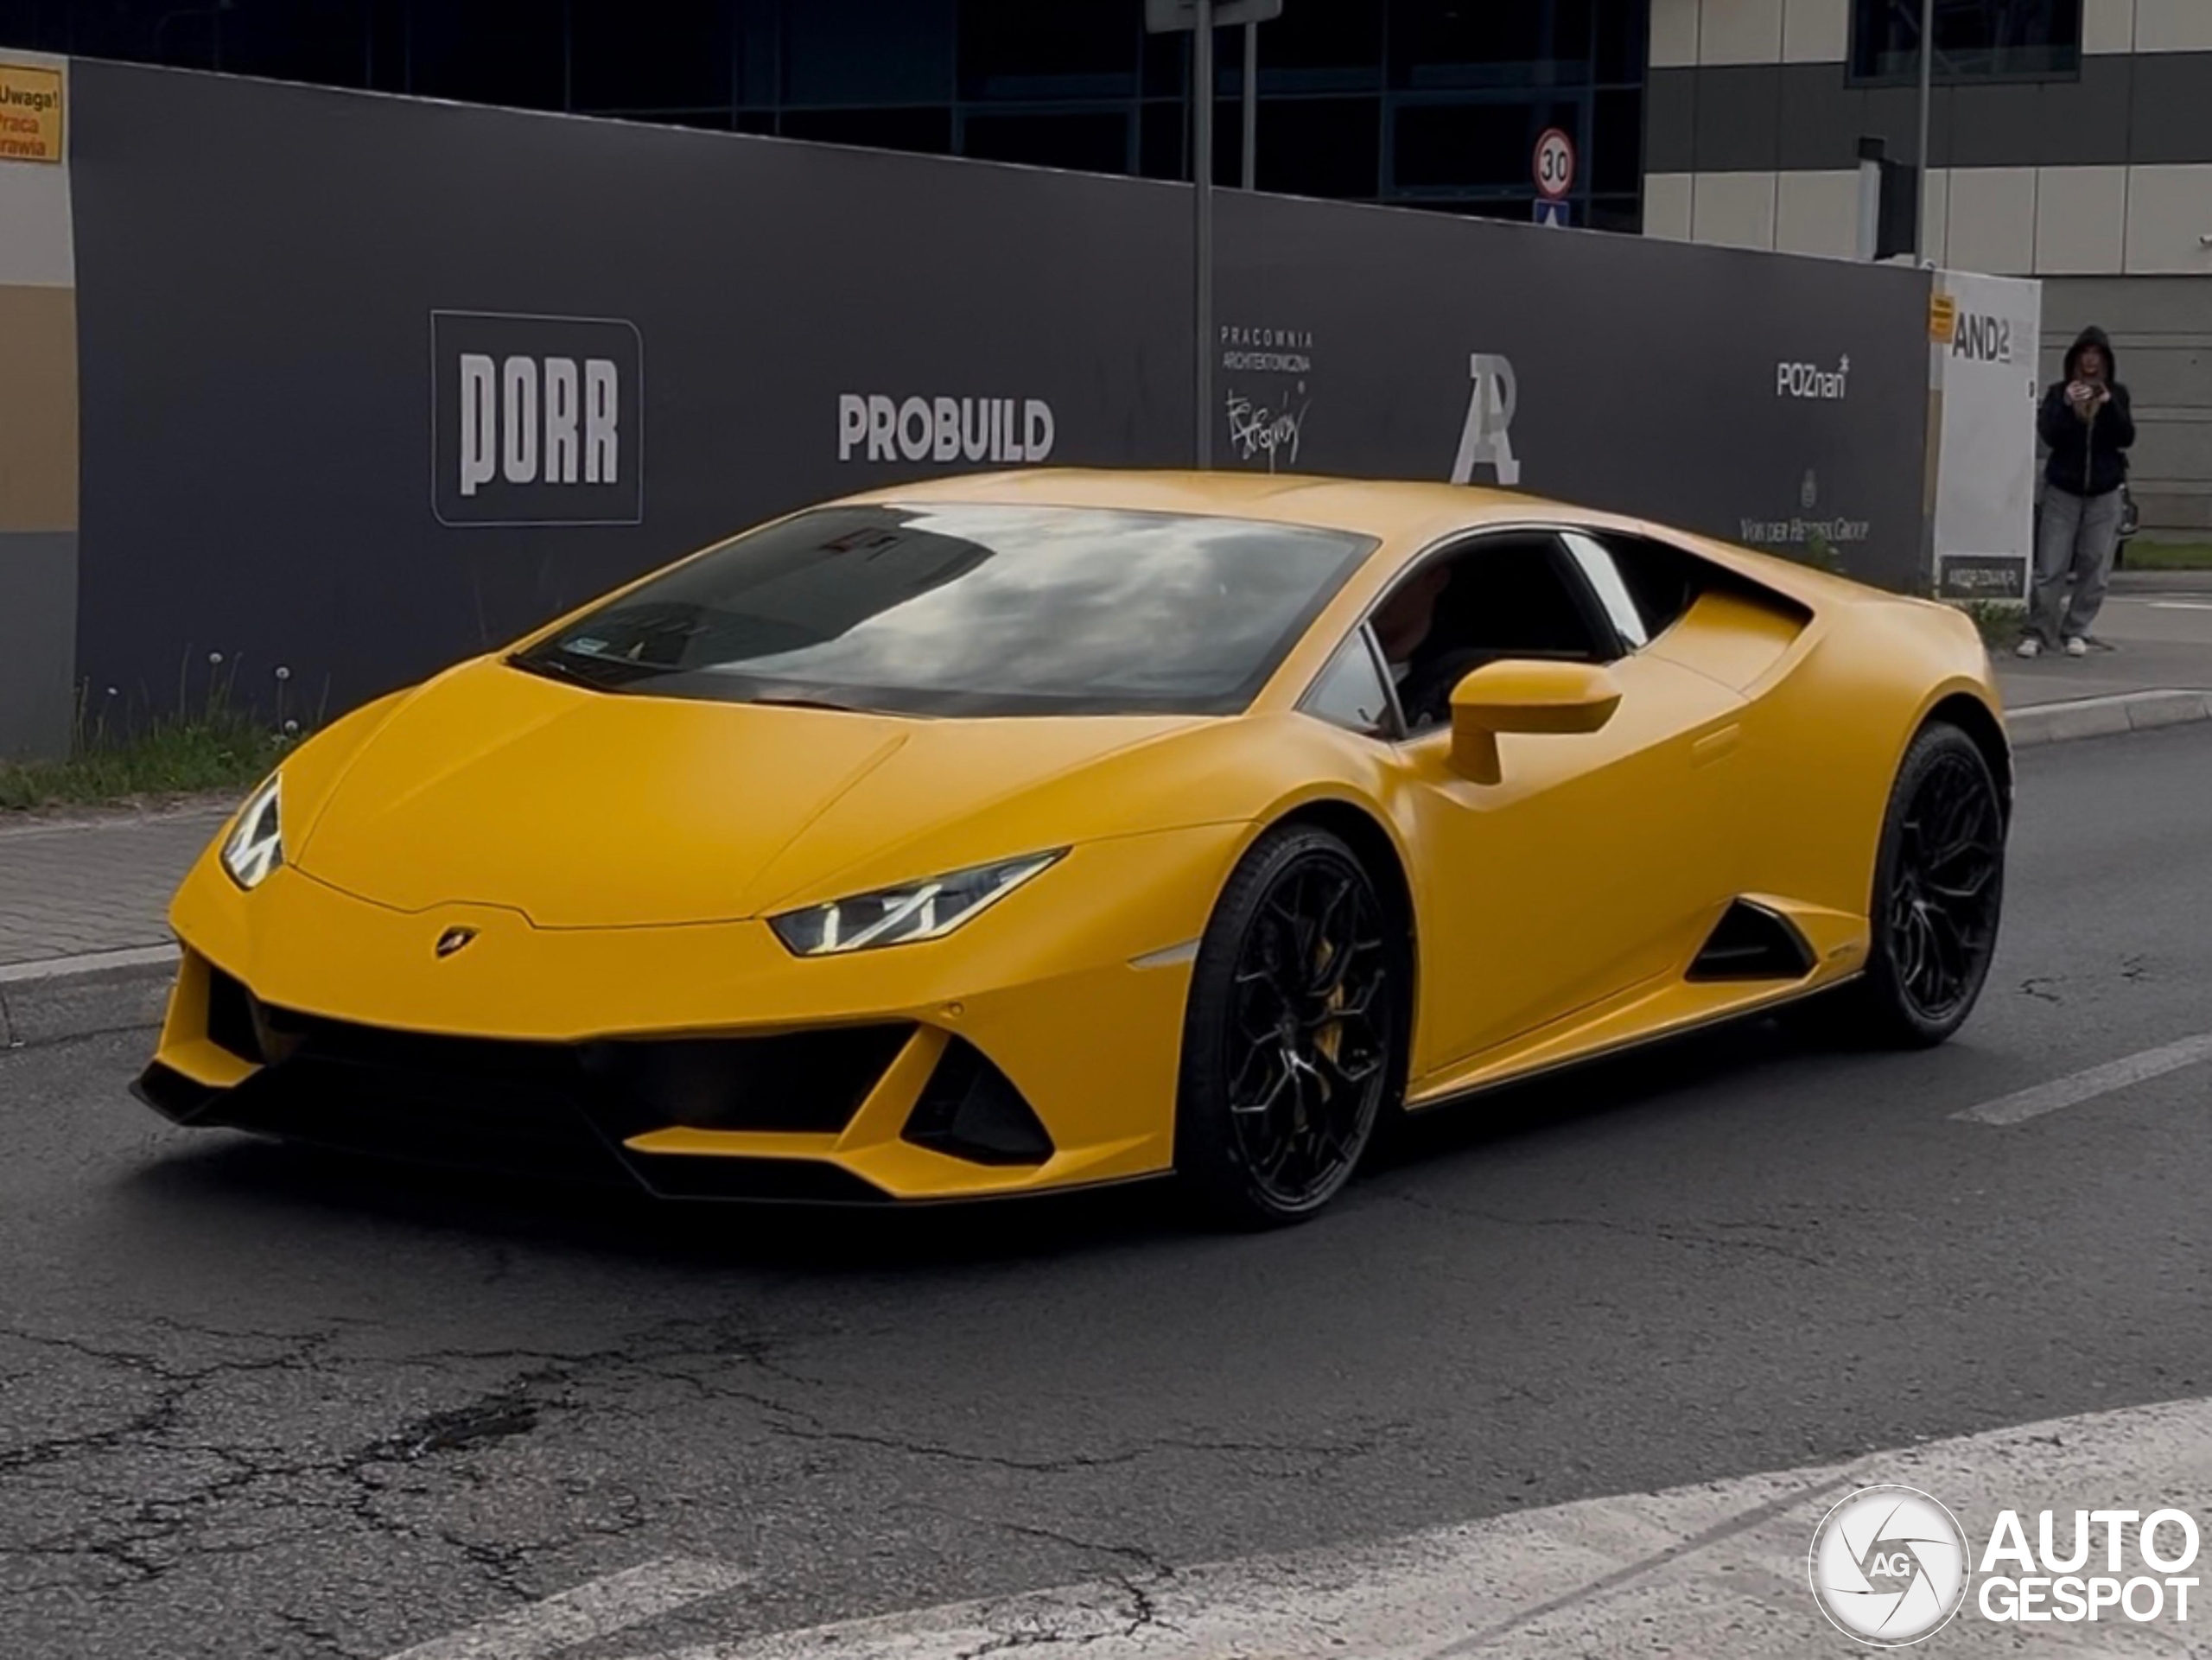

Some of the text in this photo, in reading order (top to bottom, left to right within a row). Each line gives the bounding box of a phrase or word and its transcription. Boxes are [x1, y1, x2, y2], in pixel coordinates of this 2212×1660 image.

[0, 85, 58, 111] Uwaga!
[0, 113, 39, 133] raca
[0, 138, 46, 156] rawia
[1541, 149, 1567, 181] 30
[1221, 326, 1313, 347] PRACOWNIA
[461, 353, 618, 495] PORR
[838, 394, 1054, 461] PROBUILD
